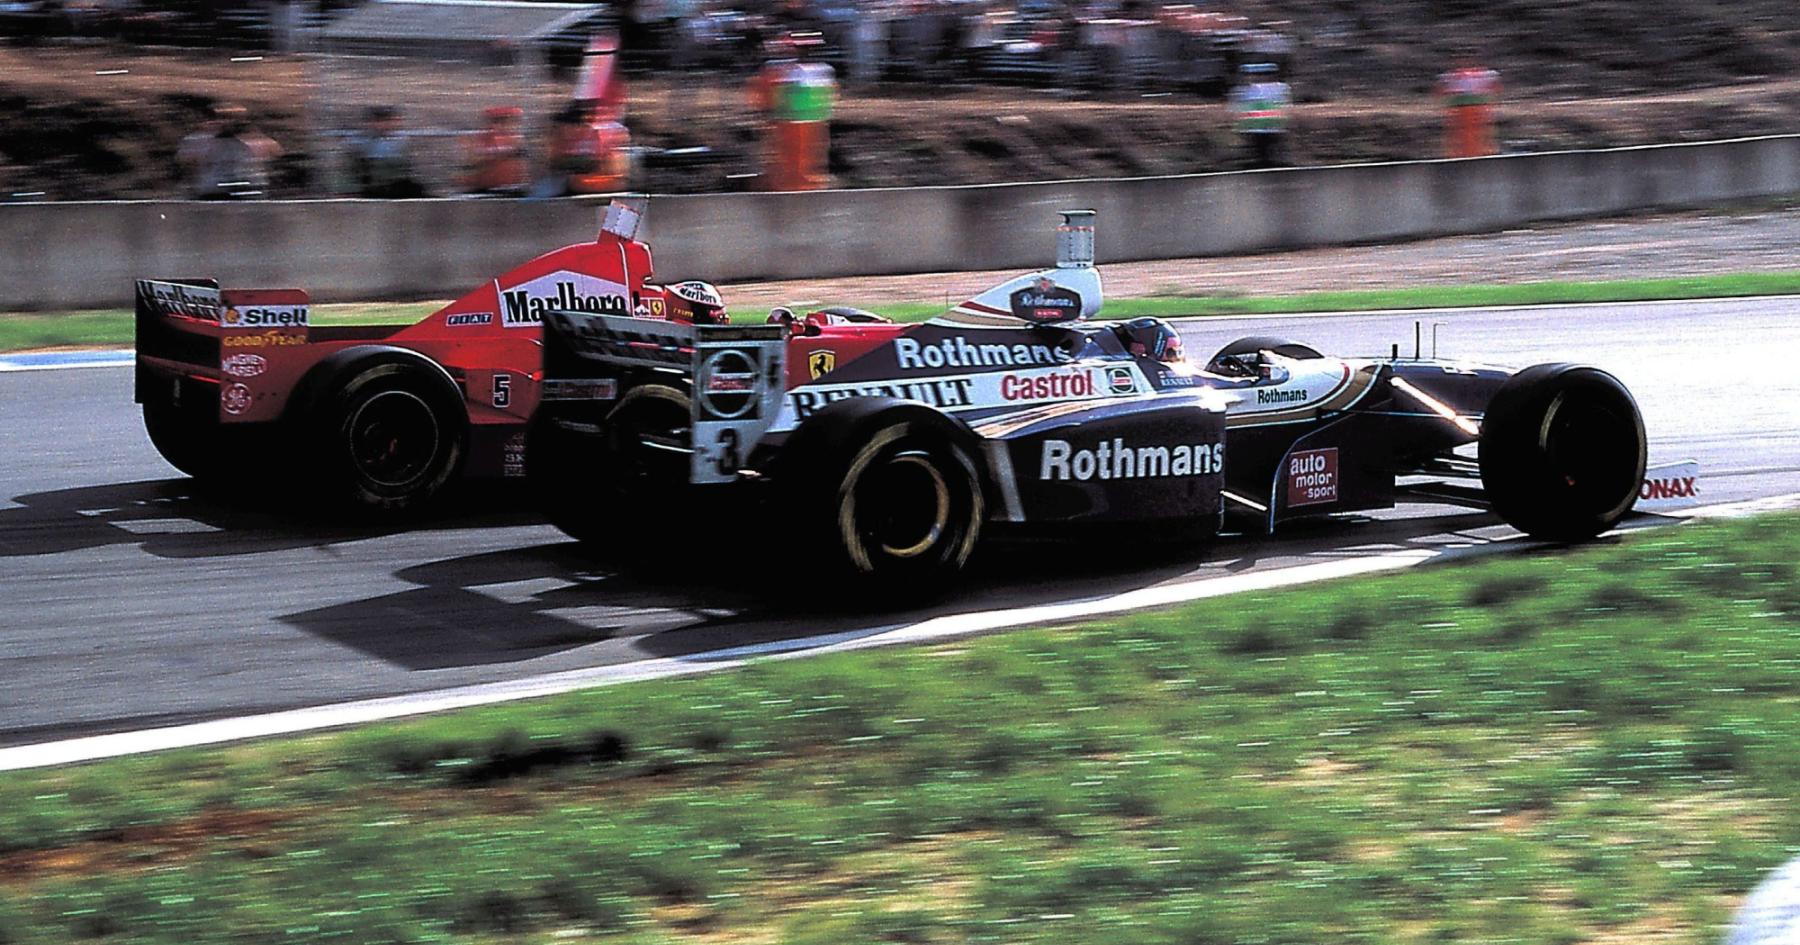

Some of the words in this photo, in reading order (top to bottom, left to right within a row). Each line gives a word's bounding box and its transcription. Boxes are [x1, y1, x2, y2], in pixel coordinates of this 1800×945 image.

[244, 308, 307, 323] Shell
[449, 314, 491, 325] FIAT
[893, 336, 1073, 369] Rothmans
[493, 374, 511, 408] 5
[1001, 370, 1094, 402] Castrol
[1257, 388, 1308, 404] Rothmans
[716, 427, 740, 476] 3
[1039, 437, 1224, 481] Rothmans
[1290, 454, 1326, 476] auto
[1295, 472, 1333, 488] motor
[1638, 476, 1697, 500] ONAX
